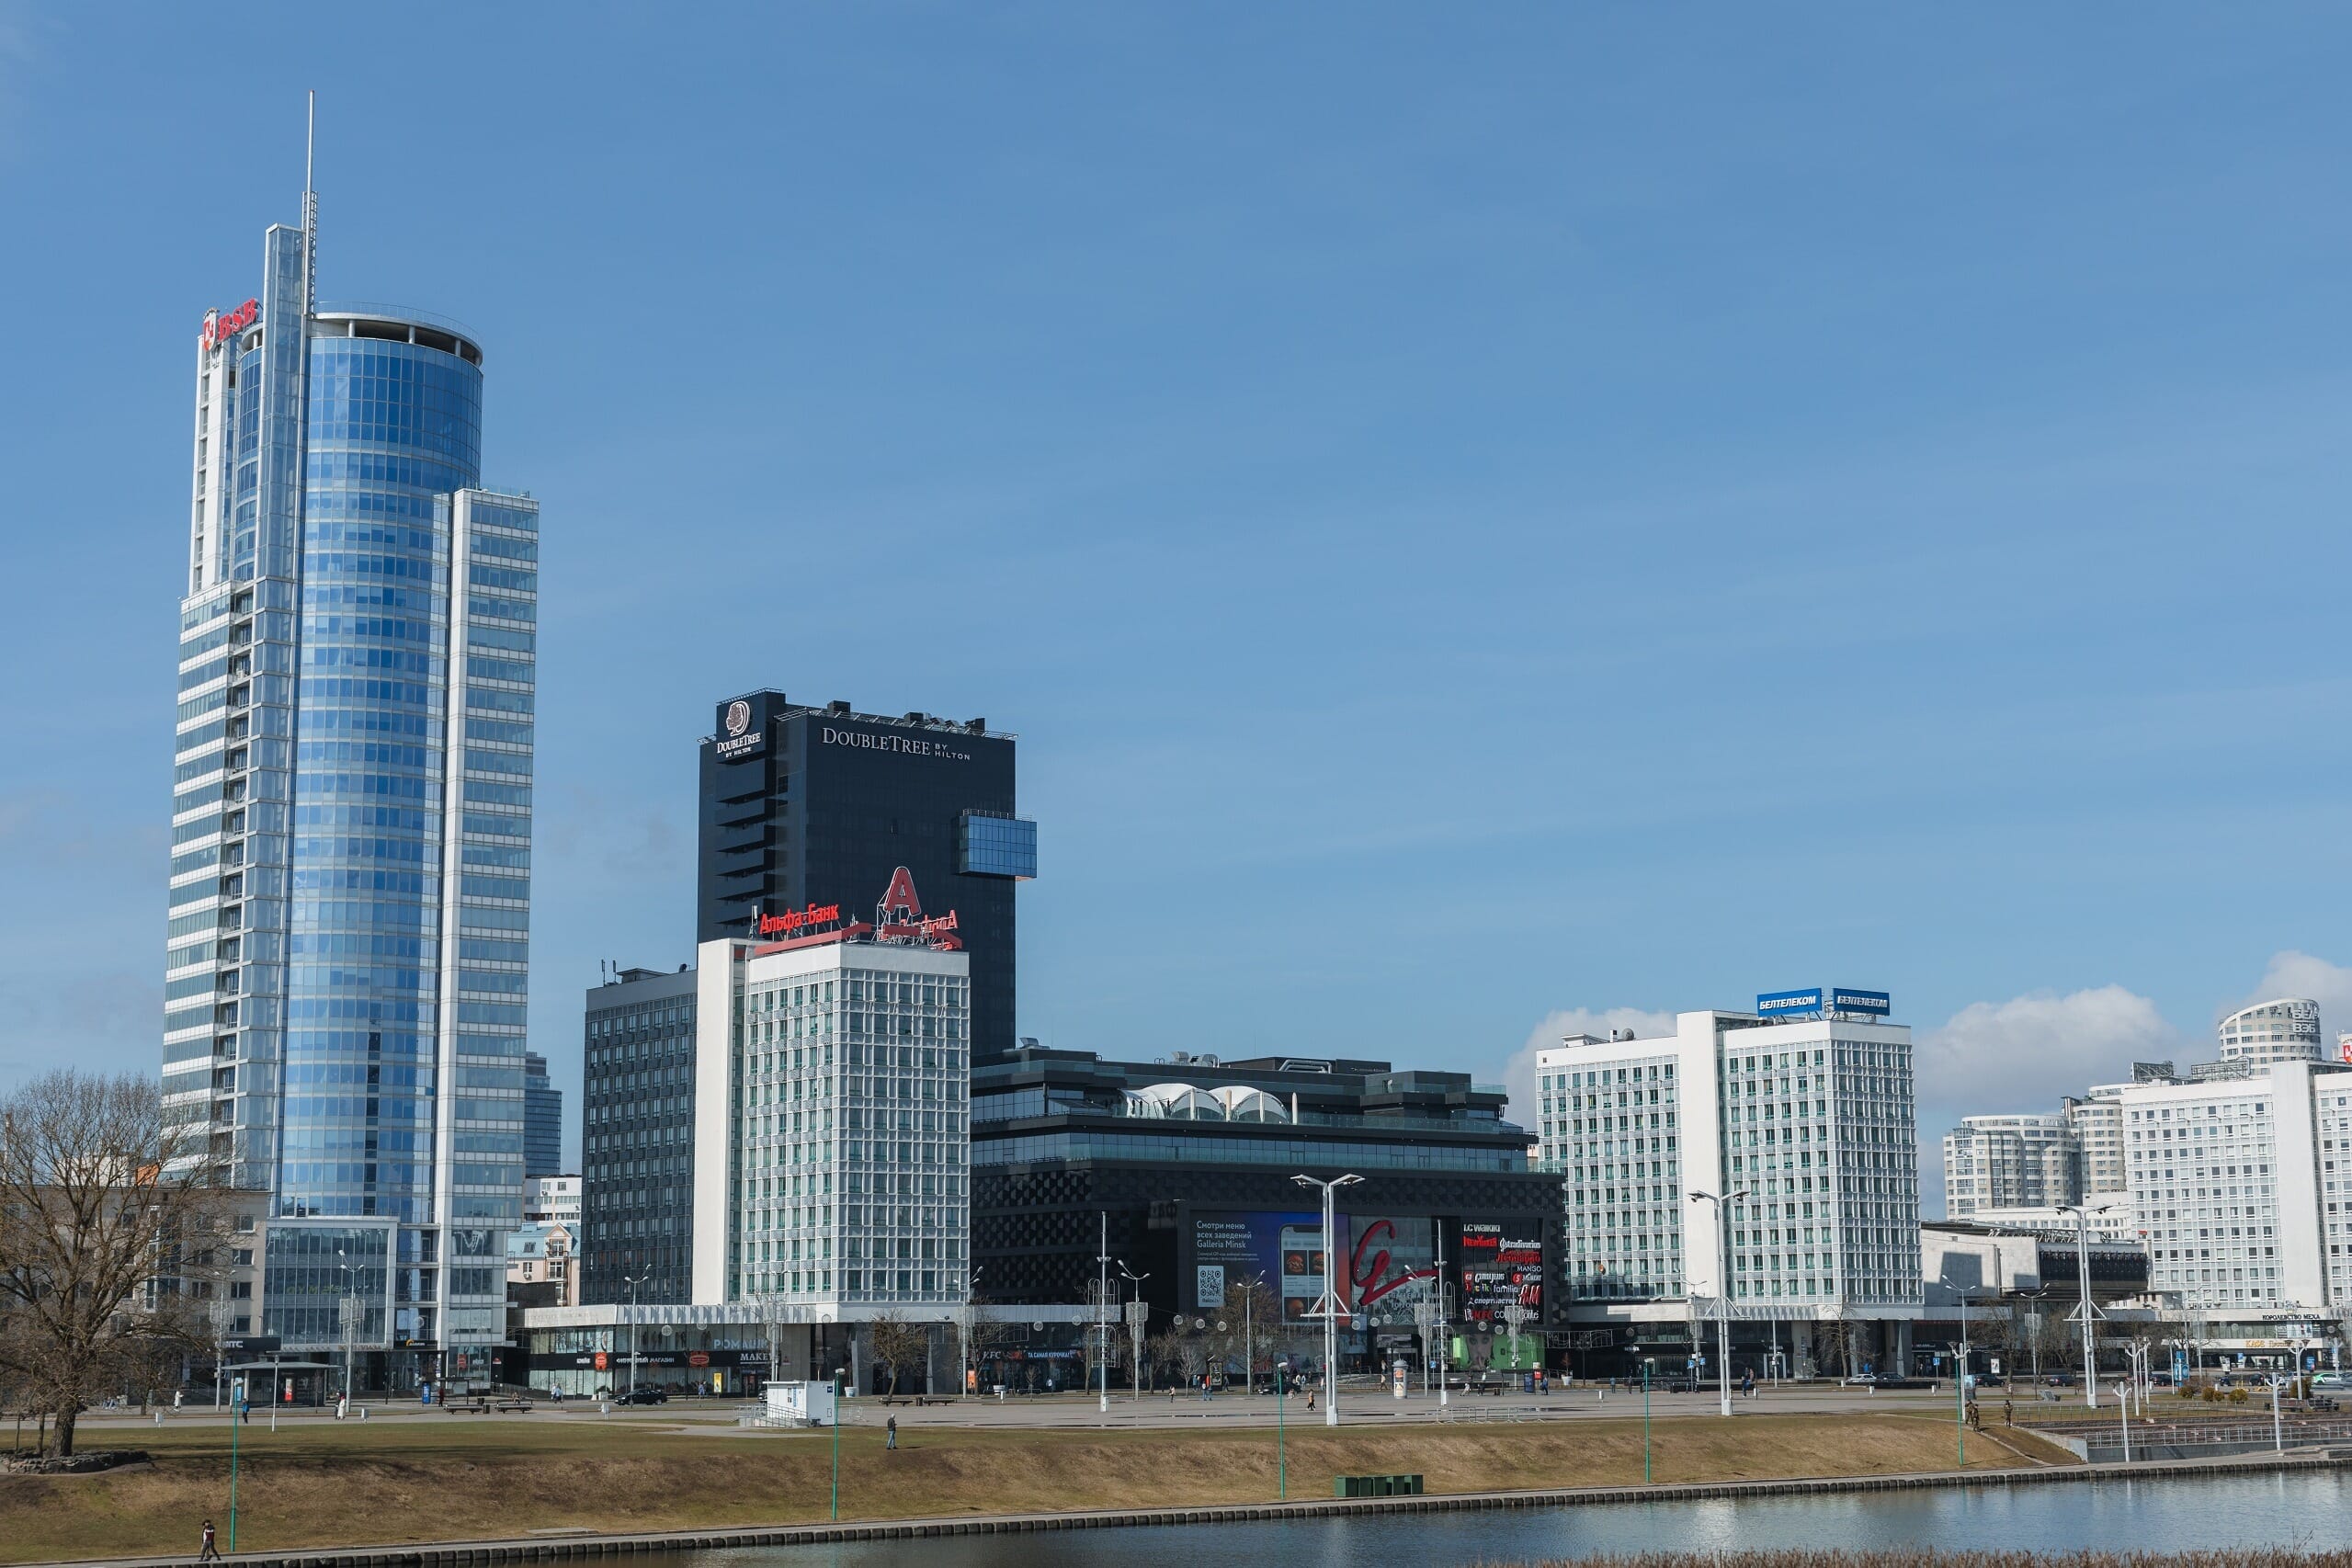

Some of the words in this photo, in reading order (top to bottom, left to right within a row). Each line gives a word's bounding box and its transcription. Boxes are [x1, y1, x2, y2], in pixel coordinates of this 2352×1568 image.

[935, 751, 971, 760] HILTON
[1759, 995, 1817, 1010] БЕЛТЕЛЕКОМ
[1837, 995, 1888, 1008] БЕЛТЕЛЕКОМ
[2292, 1023, 2315, 1033] ВЭБ
[1197, 1221, 1224, 1231] Смотри
[1214, 1232, 1252, 1240] заведений
[1197, 1239, 1224, 1248] Galleria
[1225, 1240, 1246, 1248] Minsk
